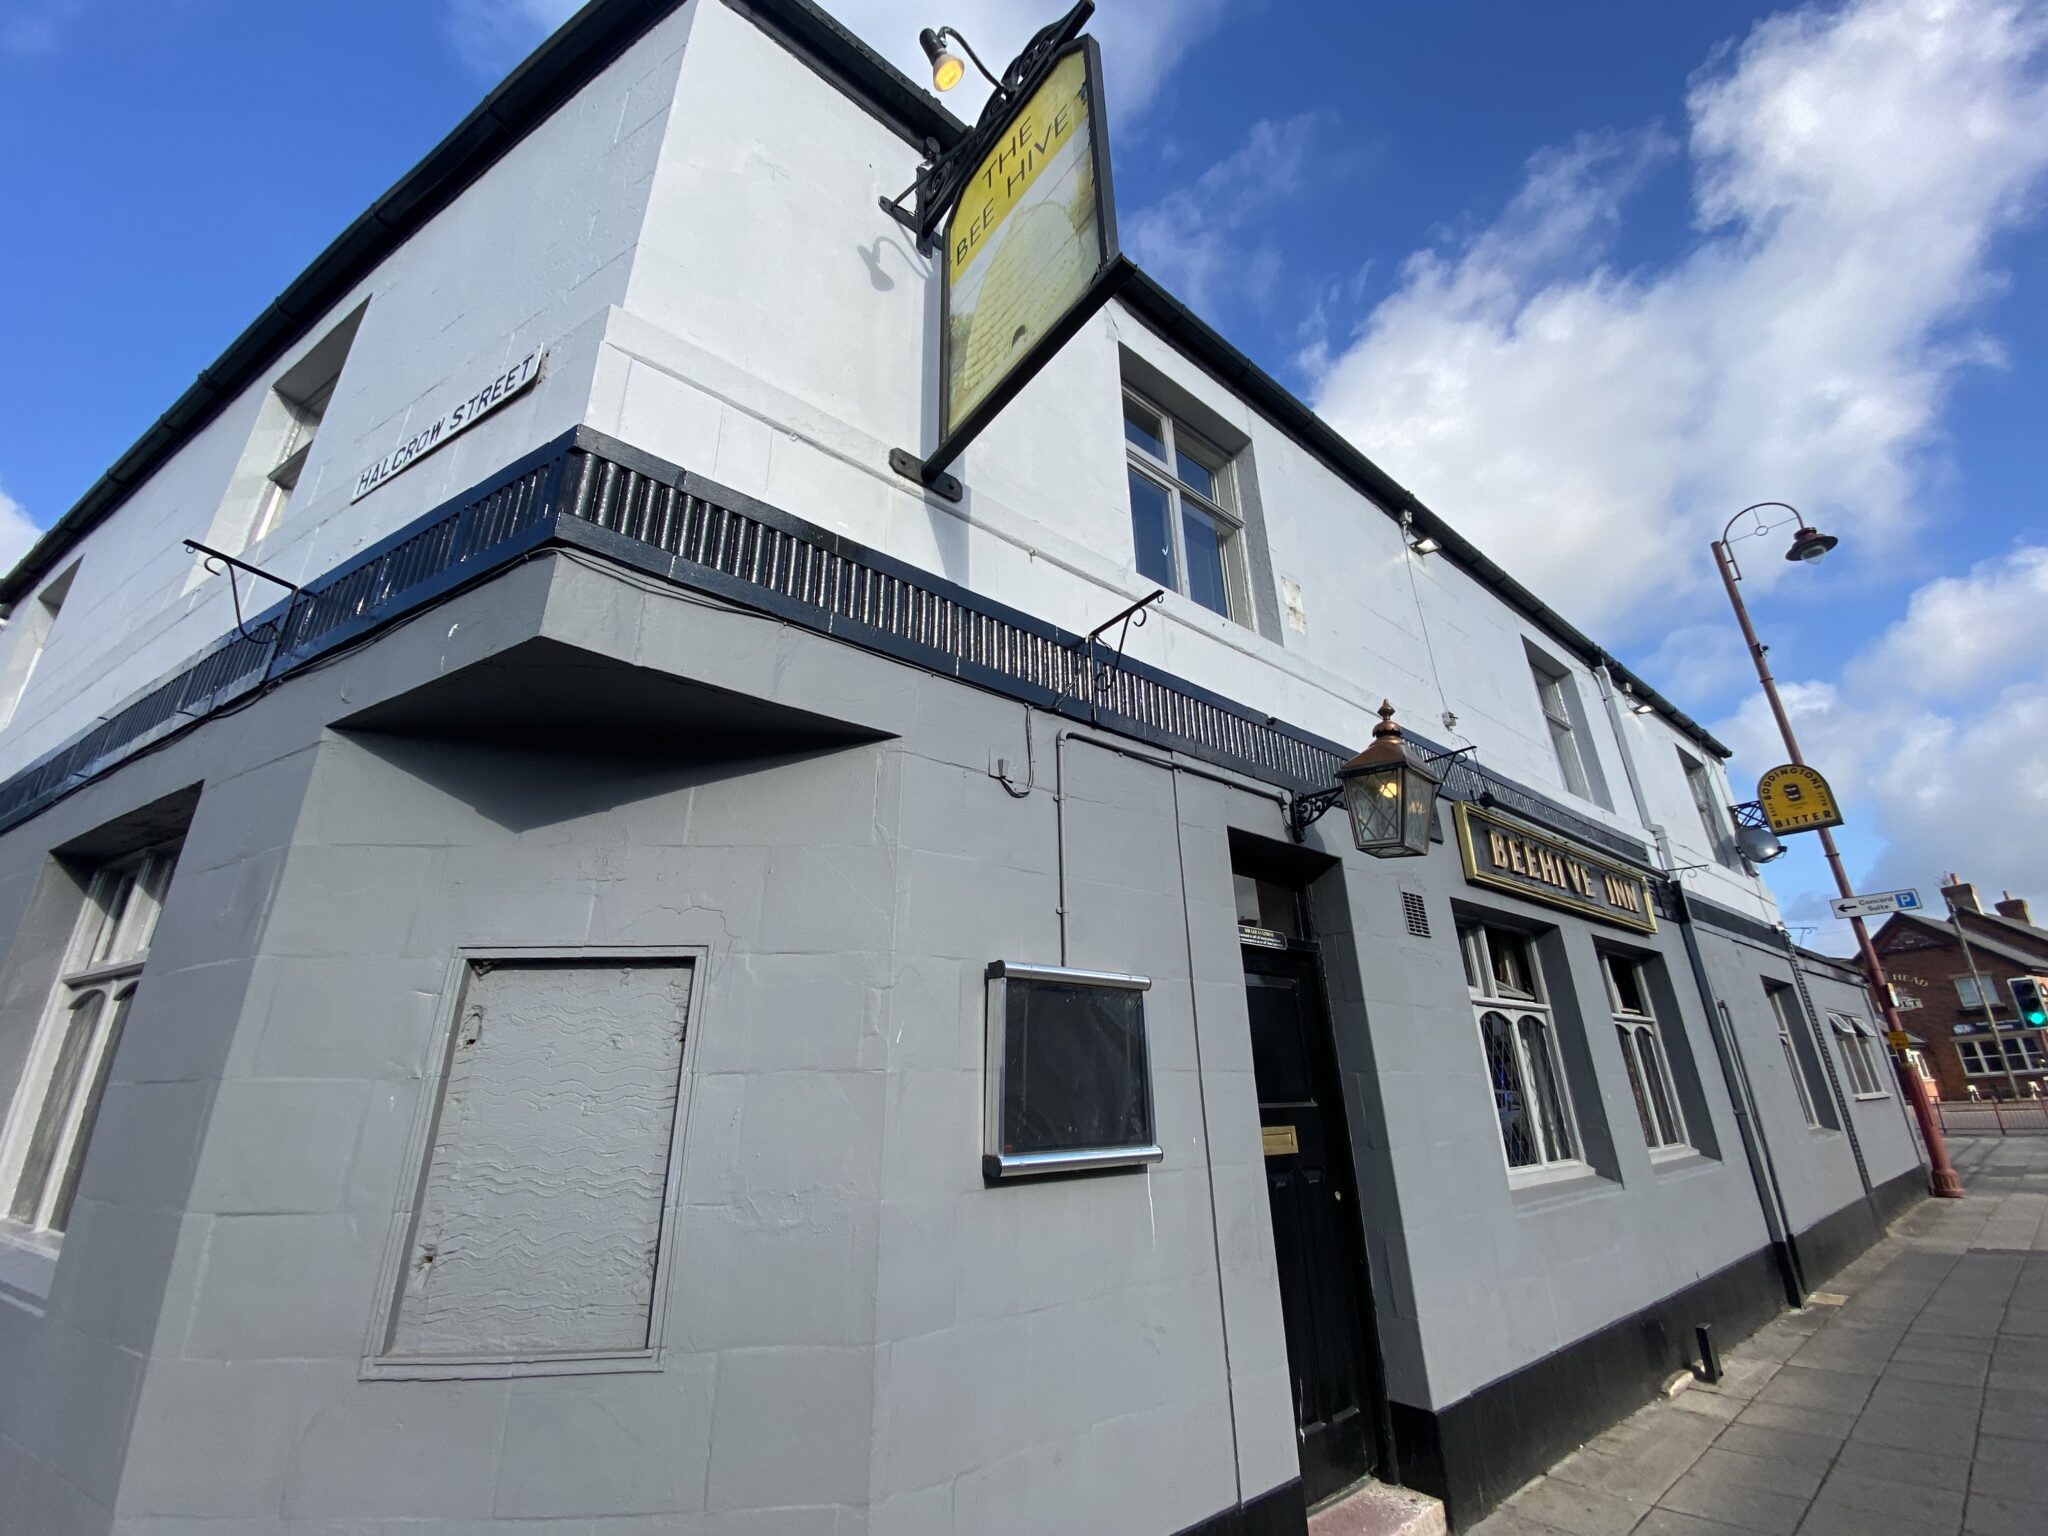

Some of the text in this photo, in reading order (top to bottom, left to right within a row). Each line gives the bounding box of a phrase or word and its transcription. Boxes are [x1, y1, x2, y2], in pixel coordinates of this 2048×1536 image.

[982, 116, 1034, 189] THE
[956, 104, 1069, 268] BEE HIVE
[356, 353, 535, 494] HALCROW STREET
[1762, 767, 1823, 801] BODDINGTONS
[1774, 810, 1832, 828] BITTER
[1488, 829, 1641, 913] BEEHIVE INN
[1900, 894, 1911, 906] P
[1892, 973, 1929, 987] HEAD
